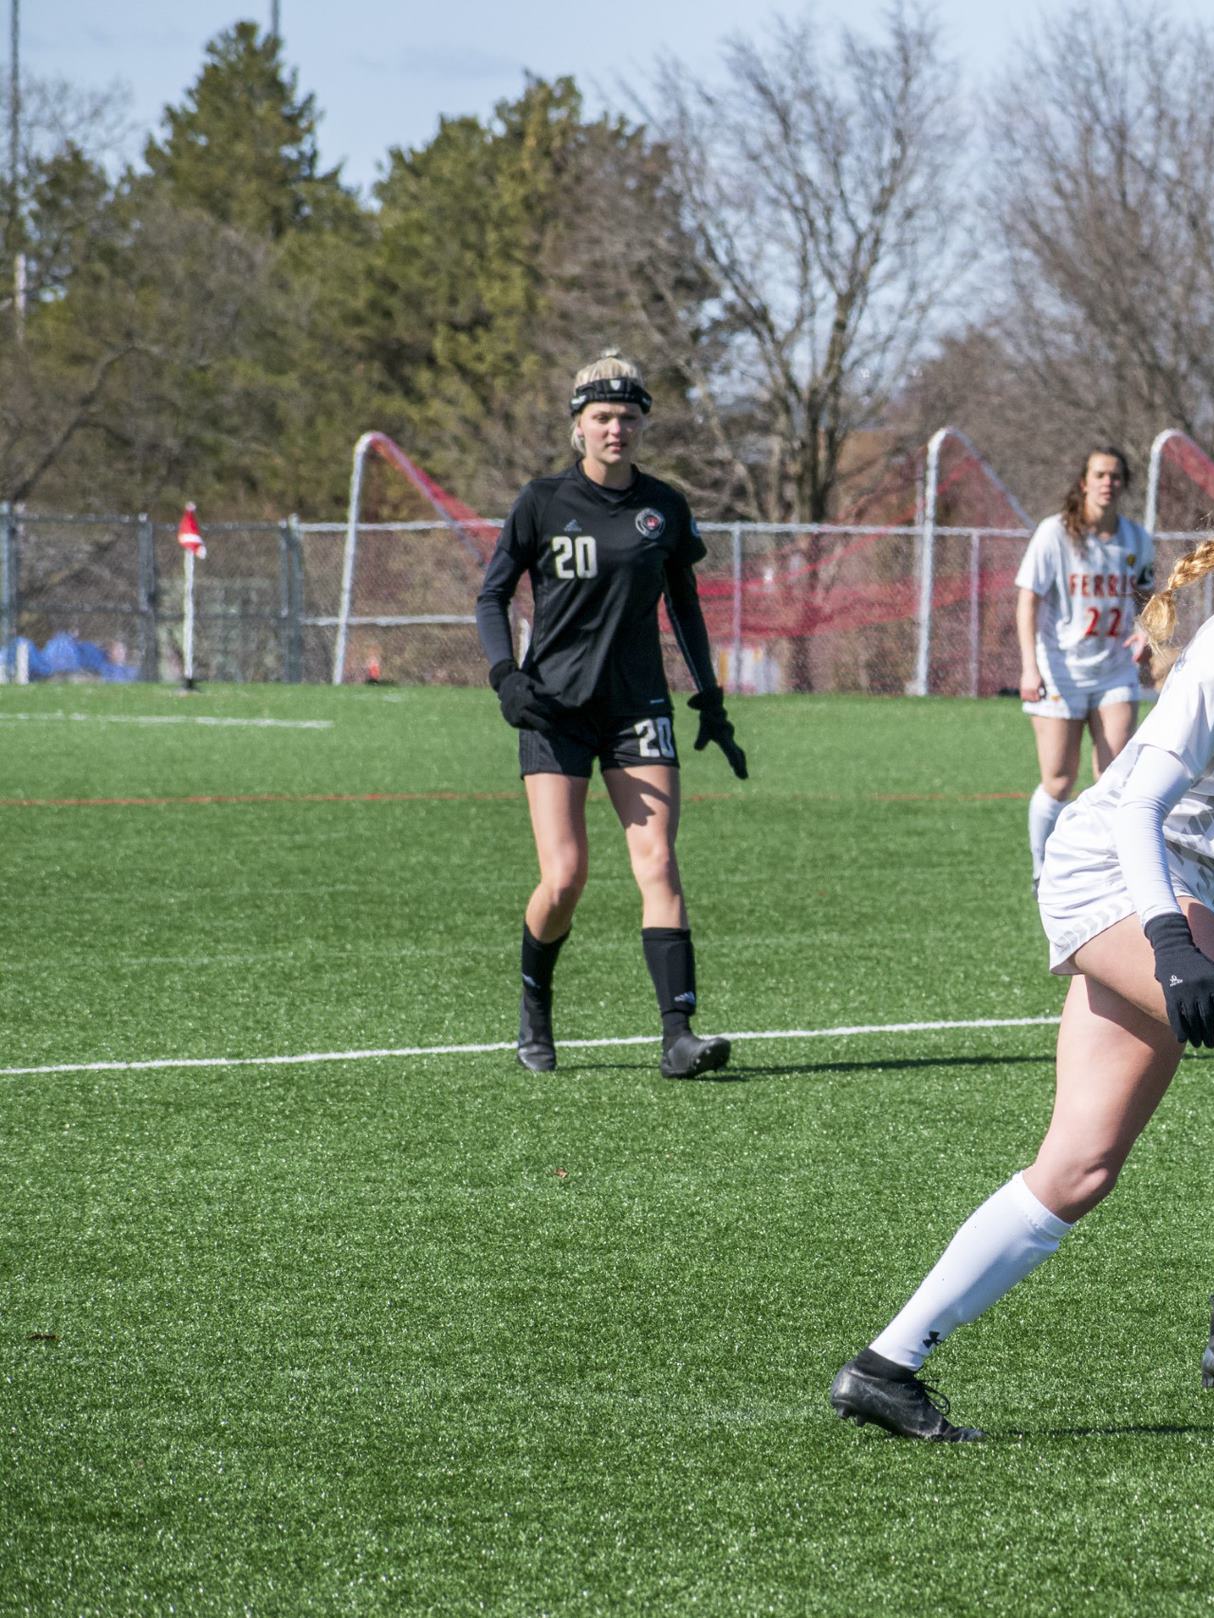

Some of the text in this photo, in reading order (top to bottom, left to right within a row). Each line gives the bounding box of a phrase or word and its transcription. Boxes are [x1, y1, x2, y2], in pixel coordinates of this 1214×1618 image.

[552, 535, 598, 579] 20
[1084, 606, 1122, 638] 22
[634, 717, 676, 758] 20
